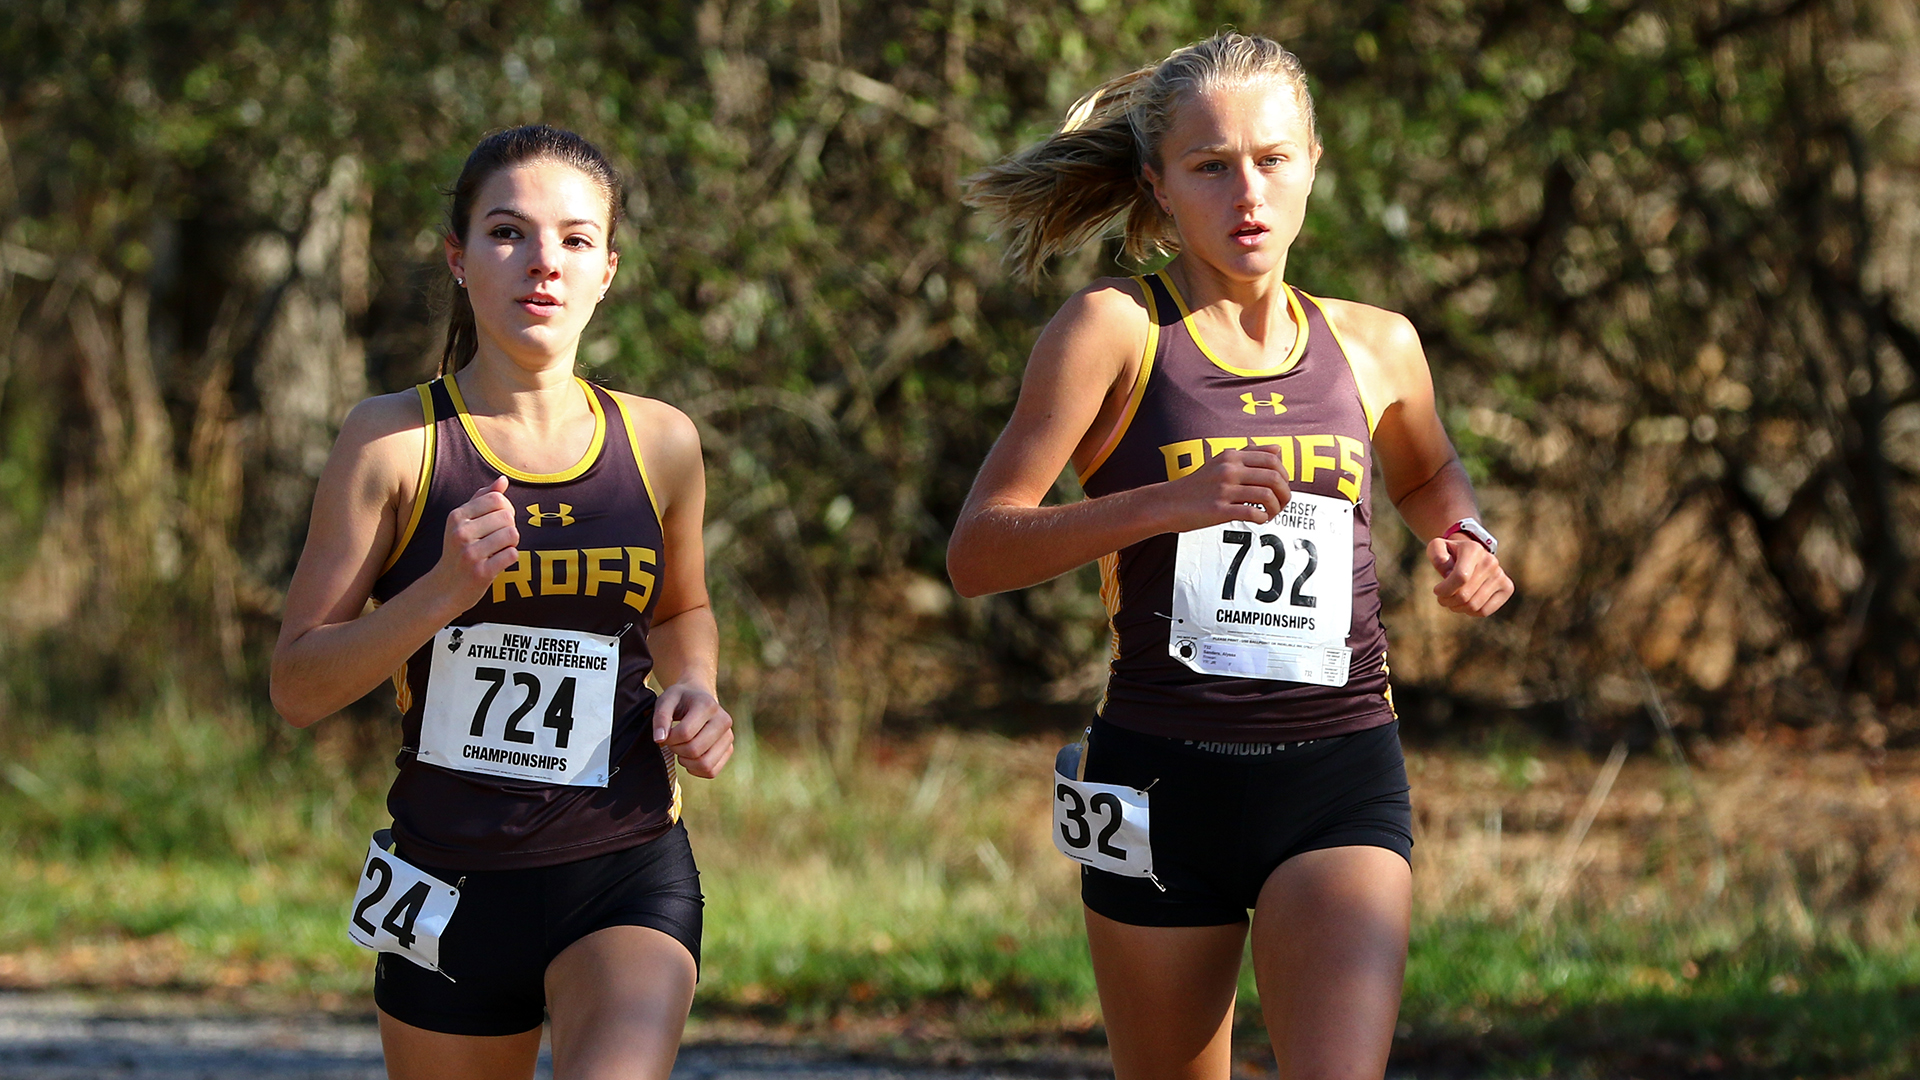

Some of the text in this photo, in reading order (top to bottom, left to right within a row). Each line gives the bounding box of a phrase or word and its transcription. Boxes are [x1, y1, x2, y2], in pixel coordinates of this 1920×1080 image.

[1283, 501, 1317, 517] ERSEY
[493, 546, 656, 613] ROFS
[1222, 529, 1318, 608] 732
[1216, 608, 1316, 631] CHAMPIONSHIPS
[467, 644, 608, 671] ATHLETIC CONFERENCE
[502, 633, 580, 654] NEW JERSEY
[469, 666, 577, 749] 724
[462, 744, 568, 772] CHAMPIONSHIPS
[1056, 783, 1127, 861] 32
[352, 856, 432, 950] 24
